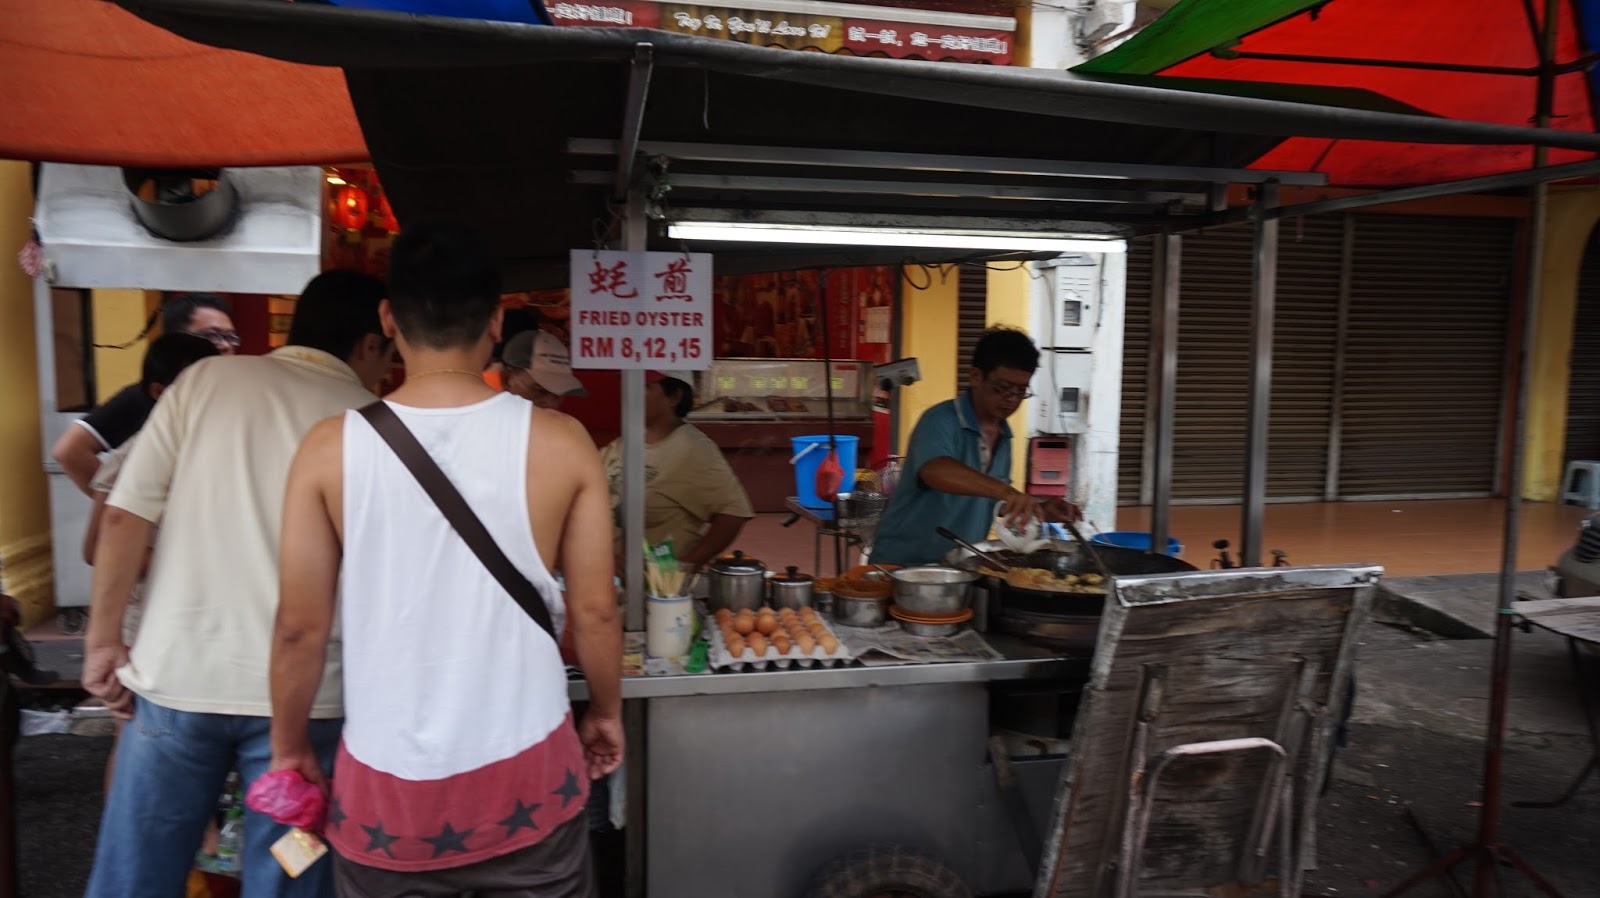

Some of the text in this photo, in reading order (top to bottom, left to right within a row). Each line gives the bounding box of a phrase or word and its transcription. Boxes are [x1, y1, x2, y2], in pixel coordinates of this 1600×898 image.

[673, 12, 703, 31] Try
[770, 20, 808, 37] Love
[587, 258, 693, 302] 蚝煎
[579, 310, 704, 327] FRIED OYSTER
[580, 336, 614, 358] RM
